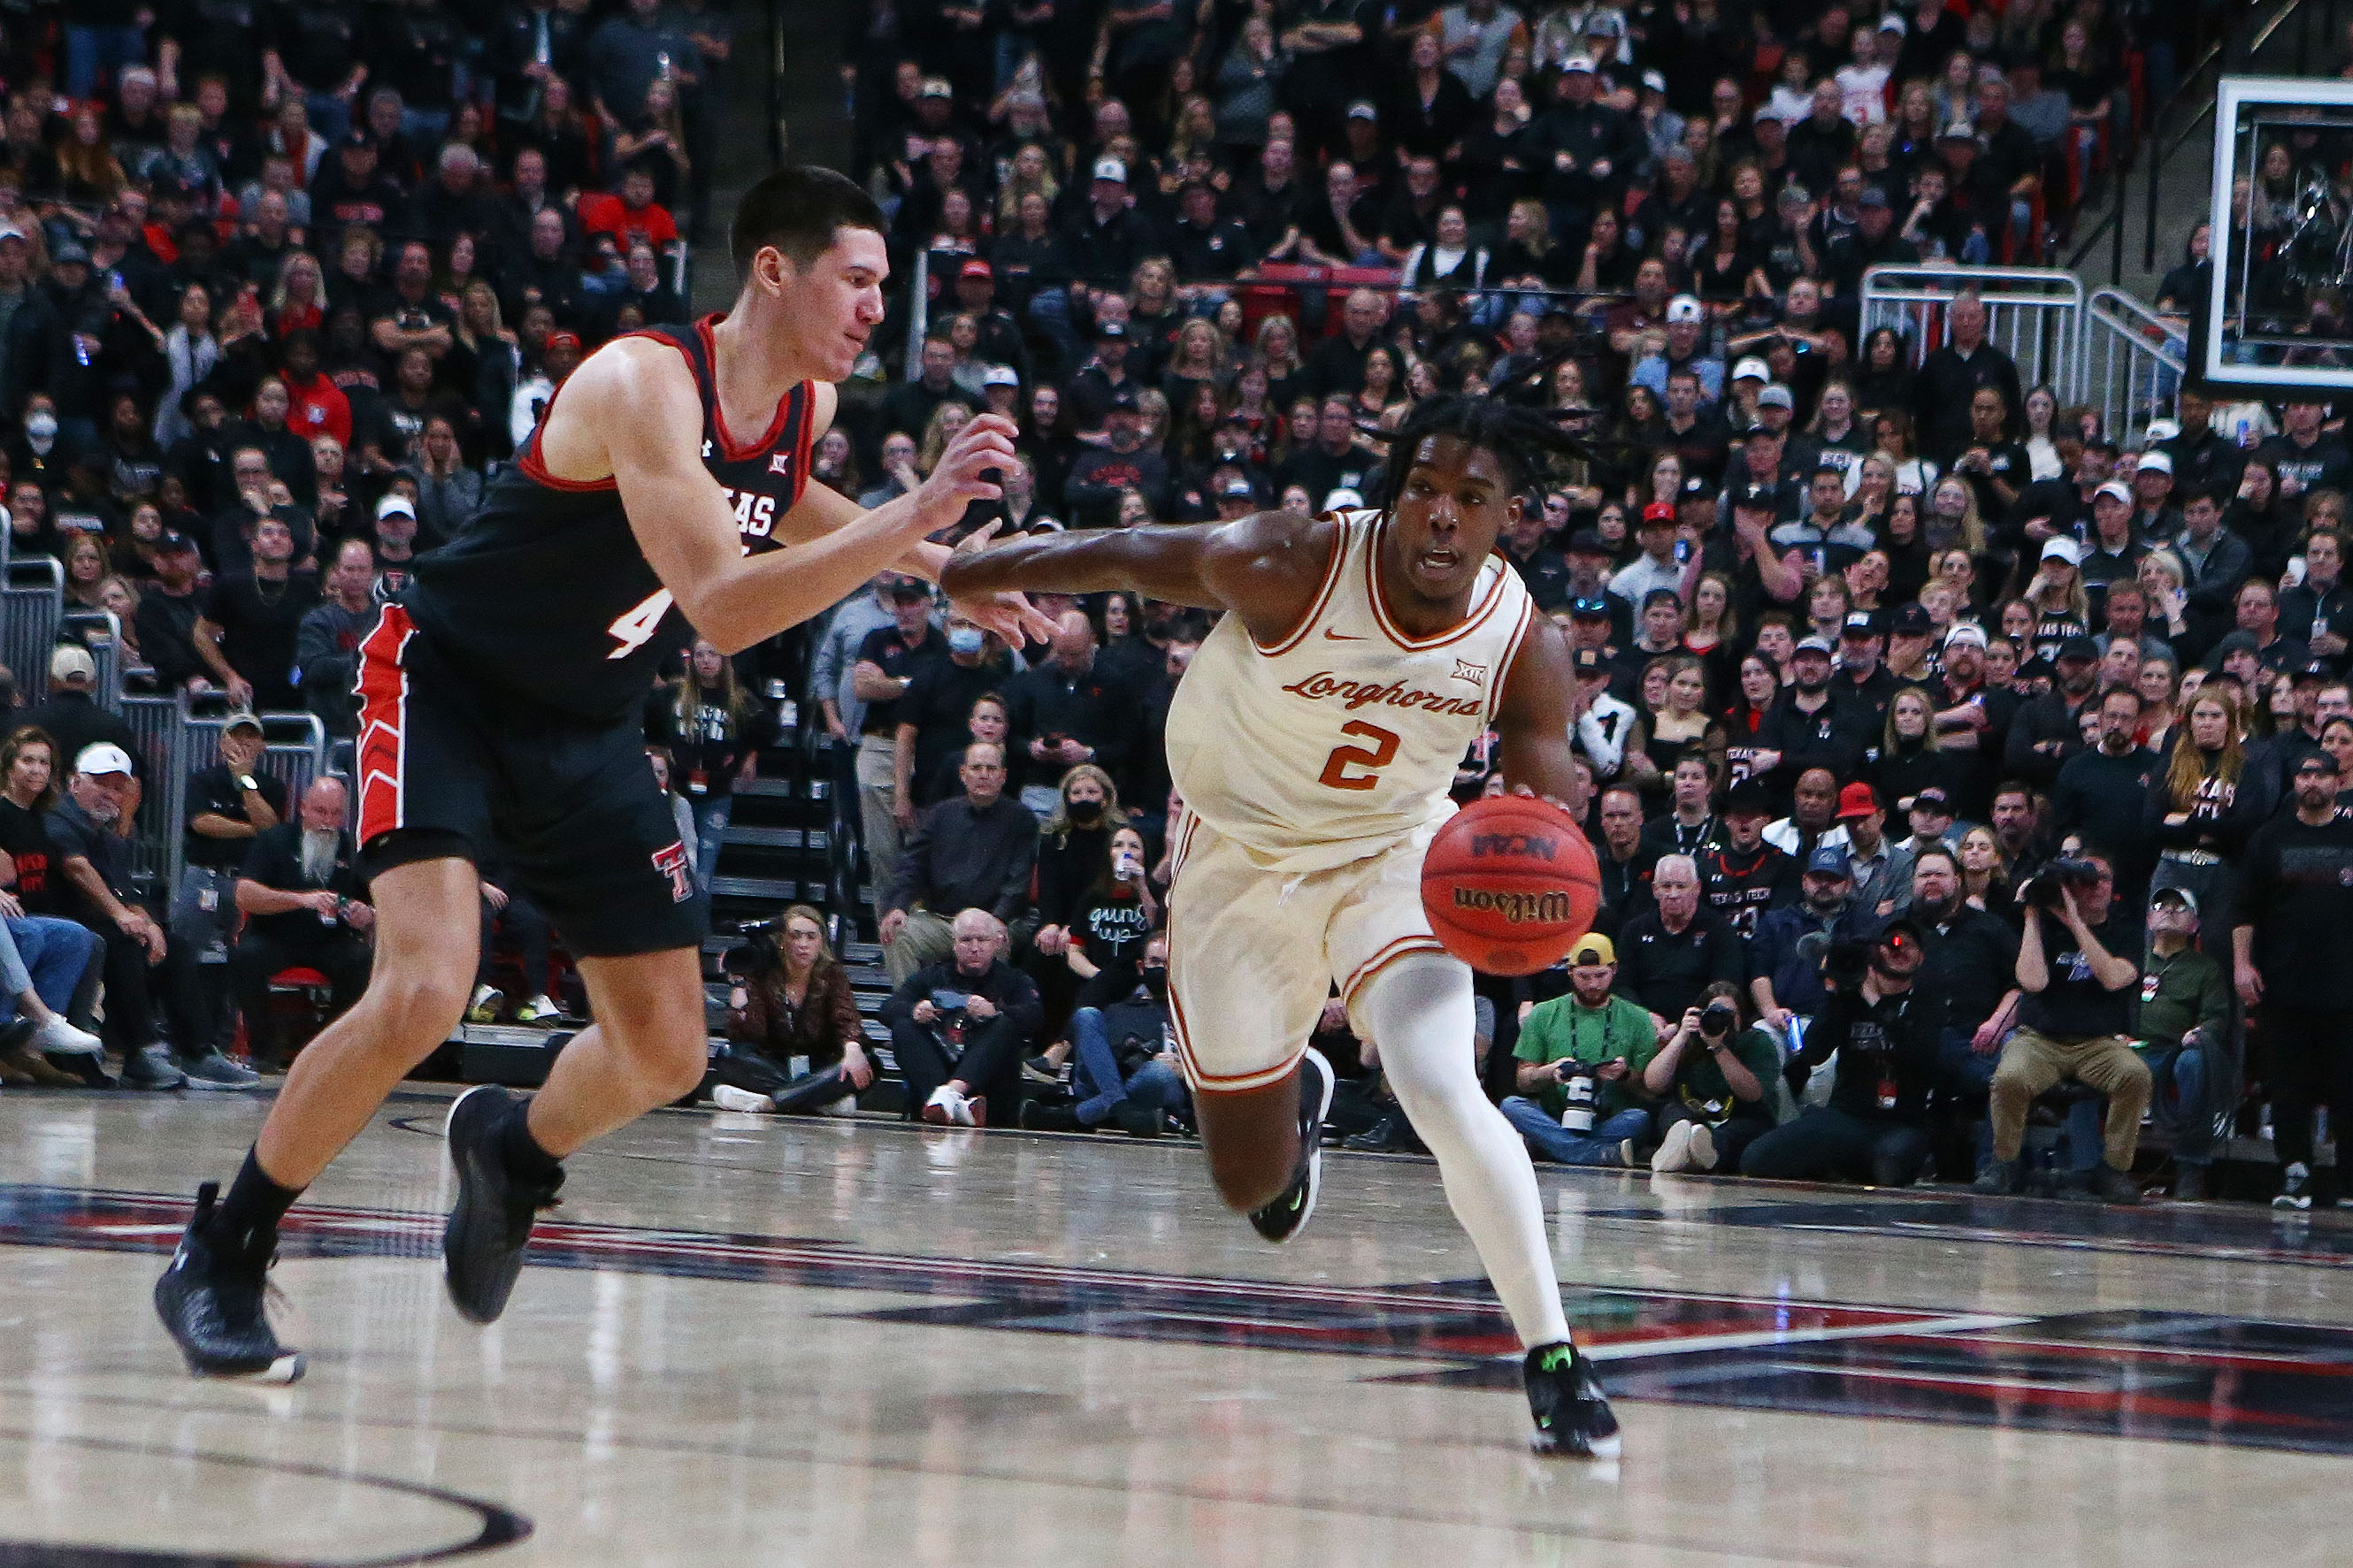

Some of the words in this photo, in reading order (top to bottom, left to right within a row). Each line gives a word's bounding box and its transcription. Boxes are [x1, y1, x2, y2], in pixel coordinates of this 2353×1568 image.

[606, 585, 675, 661] 4
[1282, 670, 1483, 715] Longhorns
[1318, 719, 1401, 791] 2
[1452, 887, 1570, 924] Wilson
